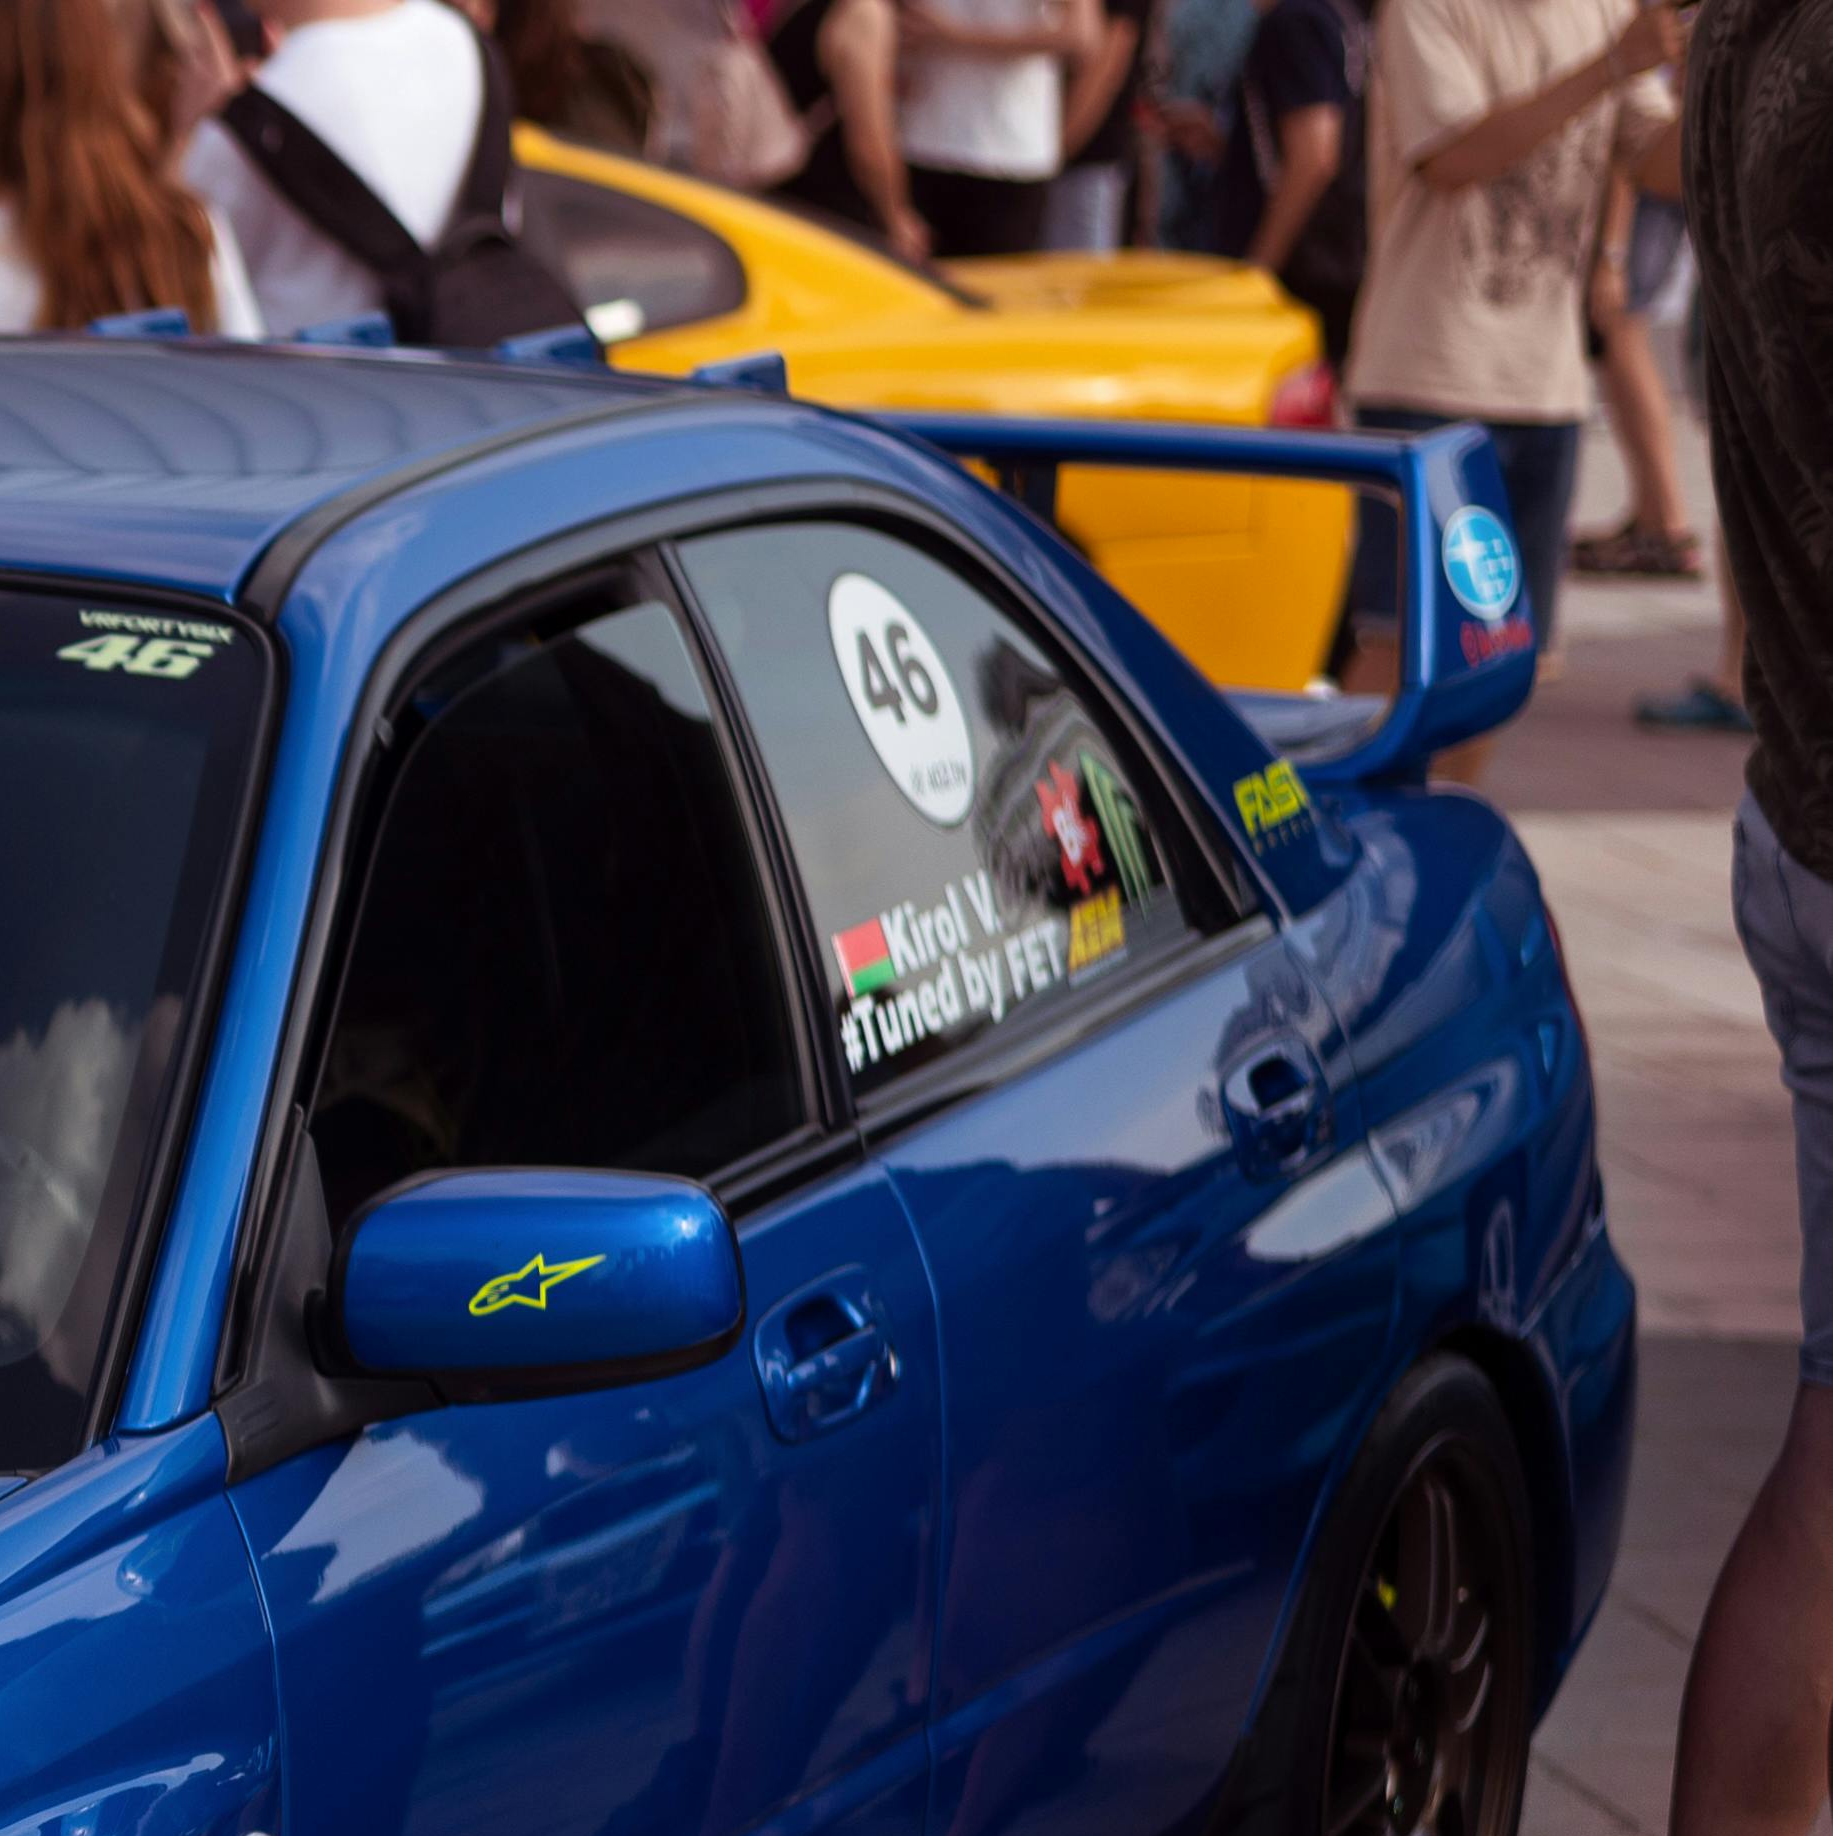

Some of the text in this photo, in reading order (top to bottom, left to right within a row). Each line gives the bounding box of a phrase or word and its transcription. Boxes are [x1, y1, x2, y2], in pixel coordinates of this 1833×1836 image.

[57, 634, 213, 678] 46
[856, 623, 938, 726] 46
[882, 882, 965, 977] Kirol
[841, 958, 957, 1074] #Tuned
[964, 948, 1005, 1023] by
[1005, 918, 1065, 1000] FET
